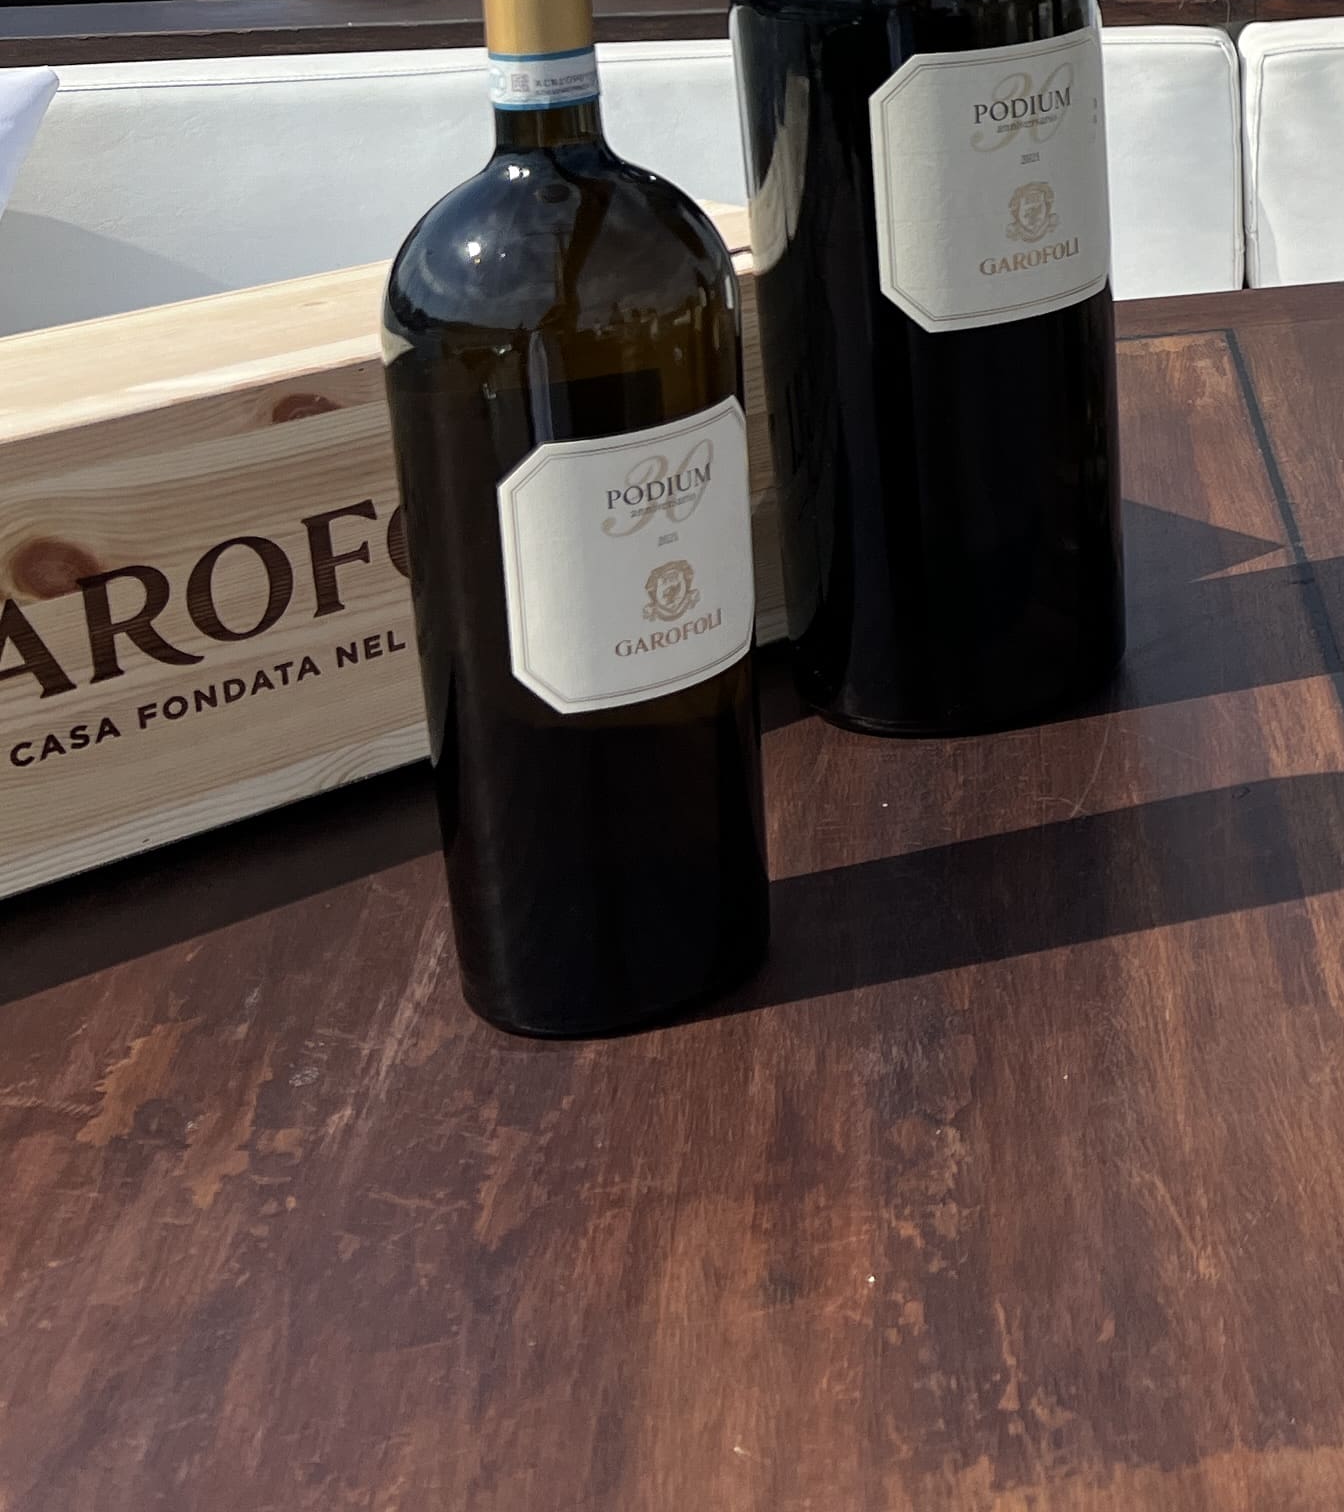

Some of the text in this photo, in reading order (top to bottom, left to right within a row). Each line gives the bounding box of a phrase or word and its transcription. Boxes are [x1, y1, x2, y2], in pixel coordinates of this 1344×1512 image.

[973, 87, 1071, 124] PODIUM
[979, 237, 1080, 276] GAROFOLI
[606, 462, 711, 510] PODIUM
[615, 608, 722, 656] GAROFOLI
[10, 630, 407, 767] CASA FONDATA NEL
